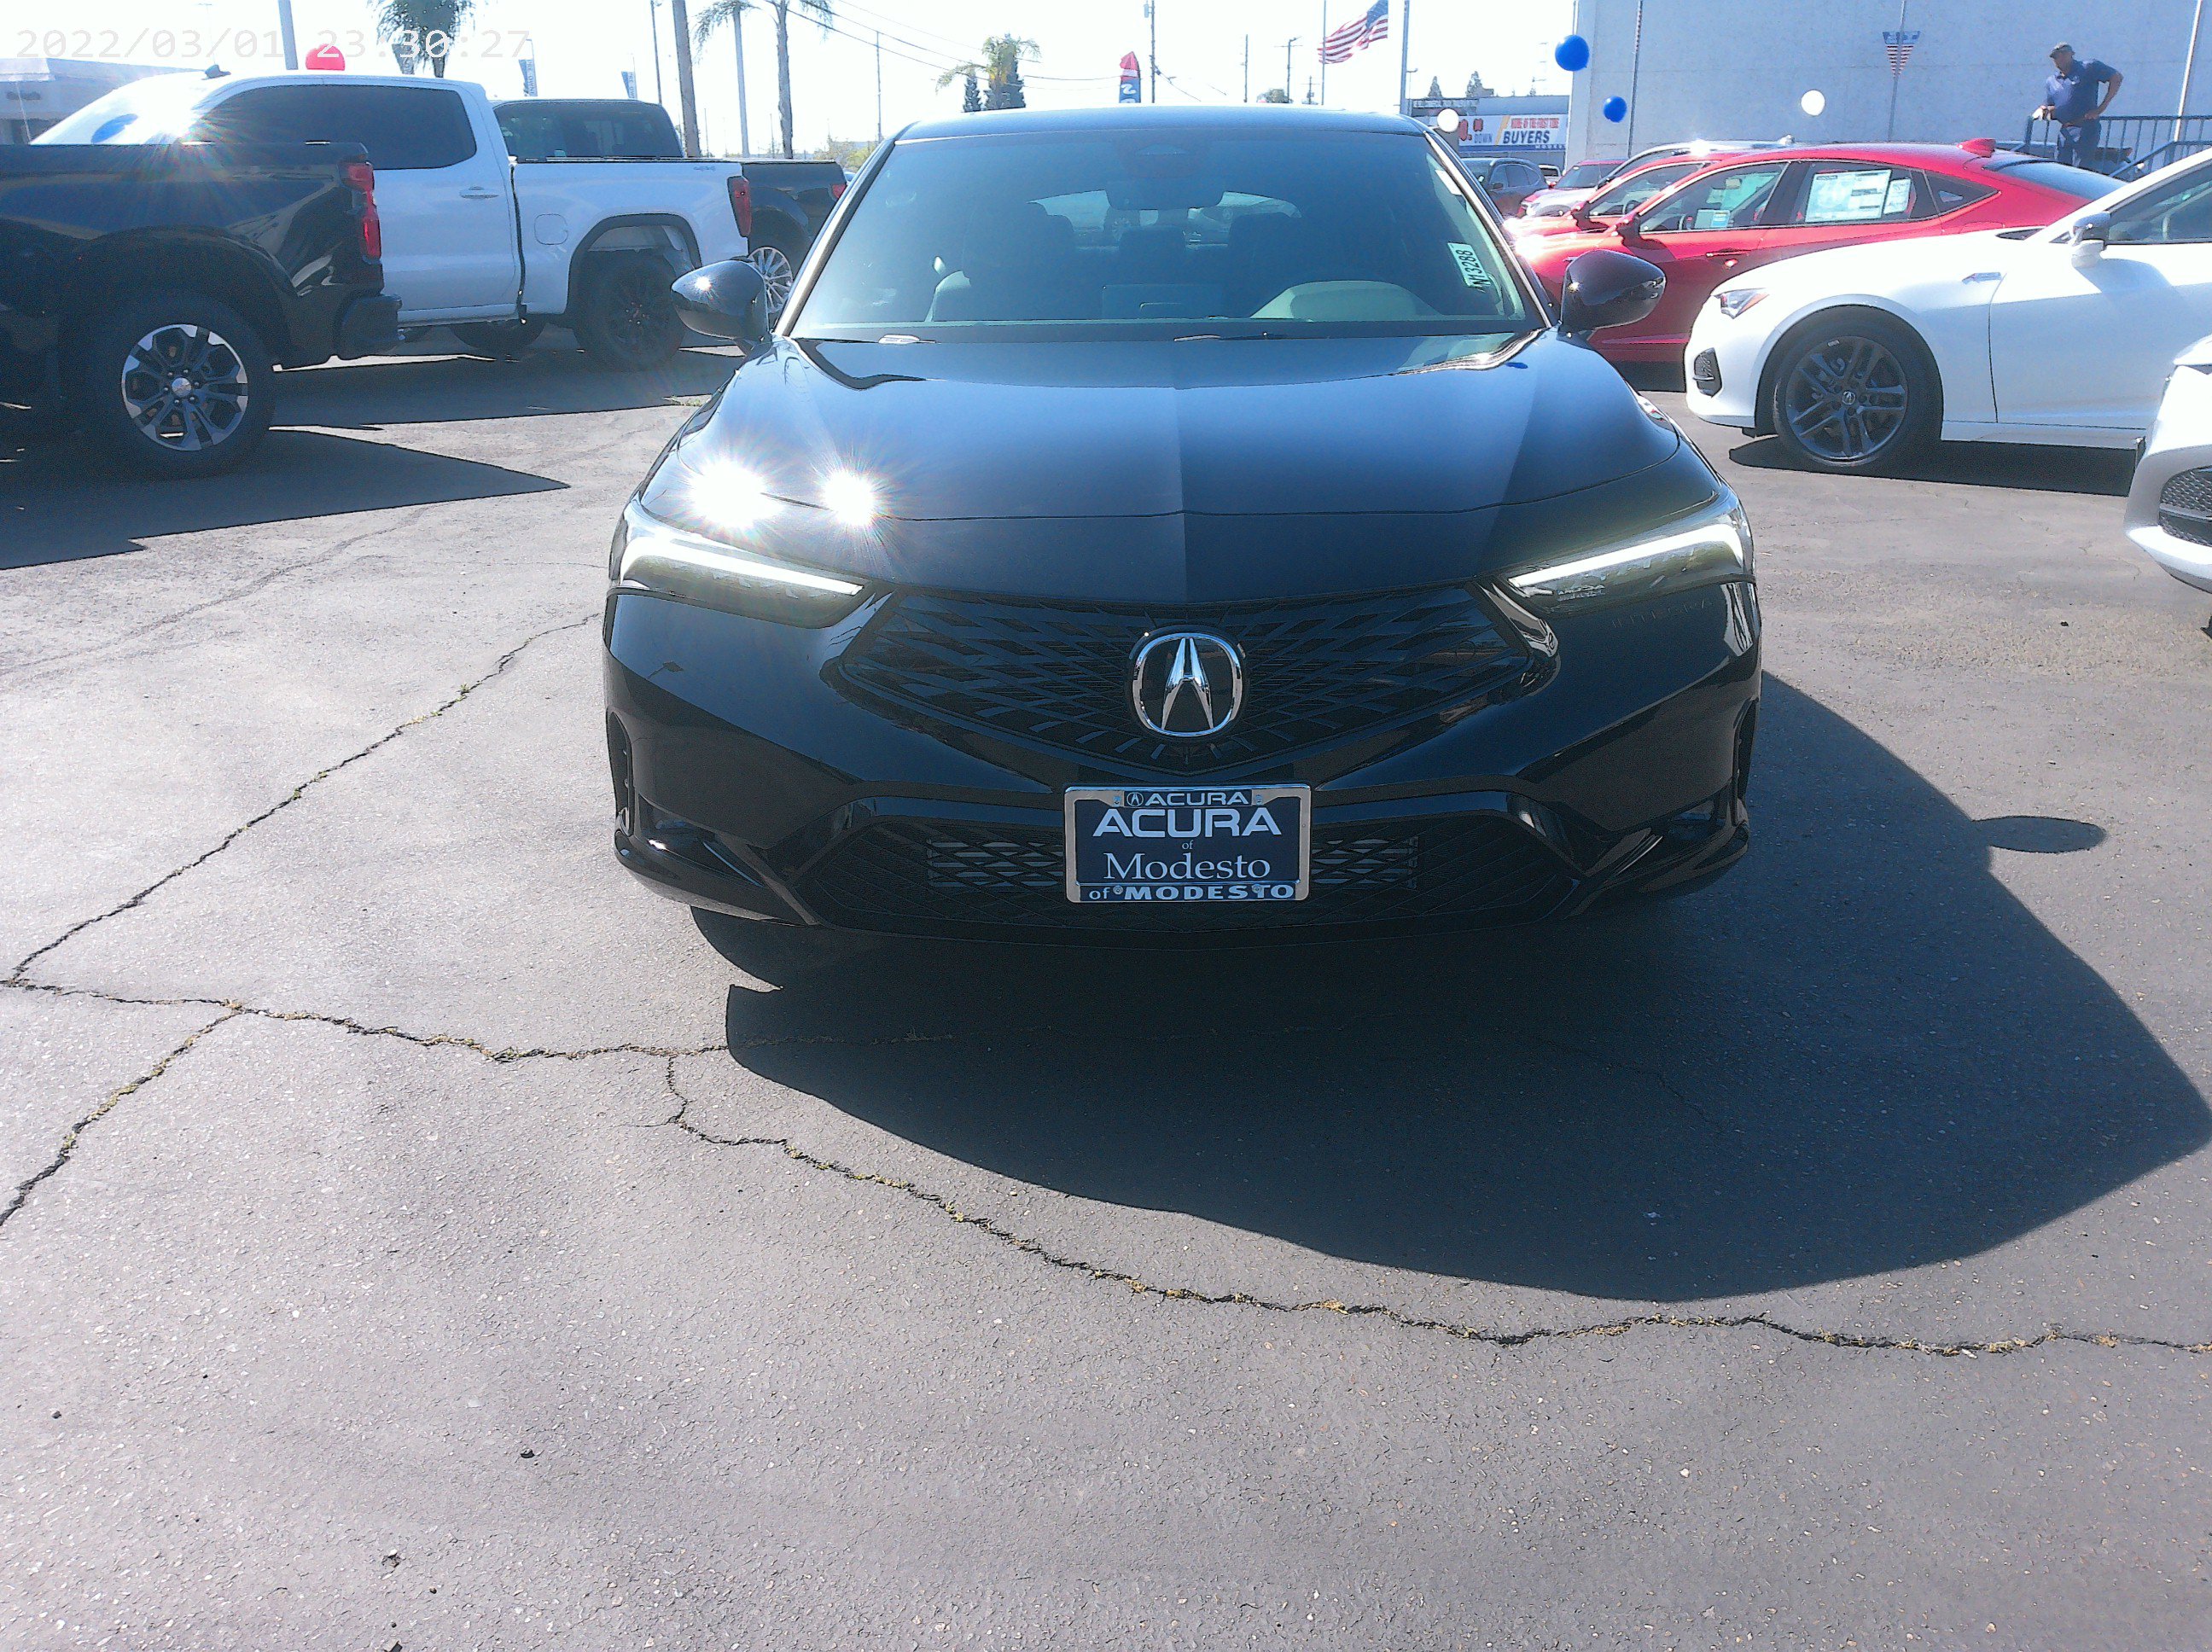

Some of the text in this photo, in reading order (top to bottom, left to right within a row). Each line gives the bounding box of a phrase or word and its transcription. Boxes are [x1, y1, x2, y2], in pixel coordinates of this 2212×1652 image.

[1503, 131, 1550, 143] BUYERS
[1144, 792, 1249, 806] ACURA
[1092, 807, 1282, 838] ACURA
[1181, 839, 1194, 850] of
[1103, 852, 1271, 880] Modesto
[1089, 884, 1295, 900] of MODESTO
